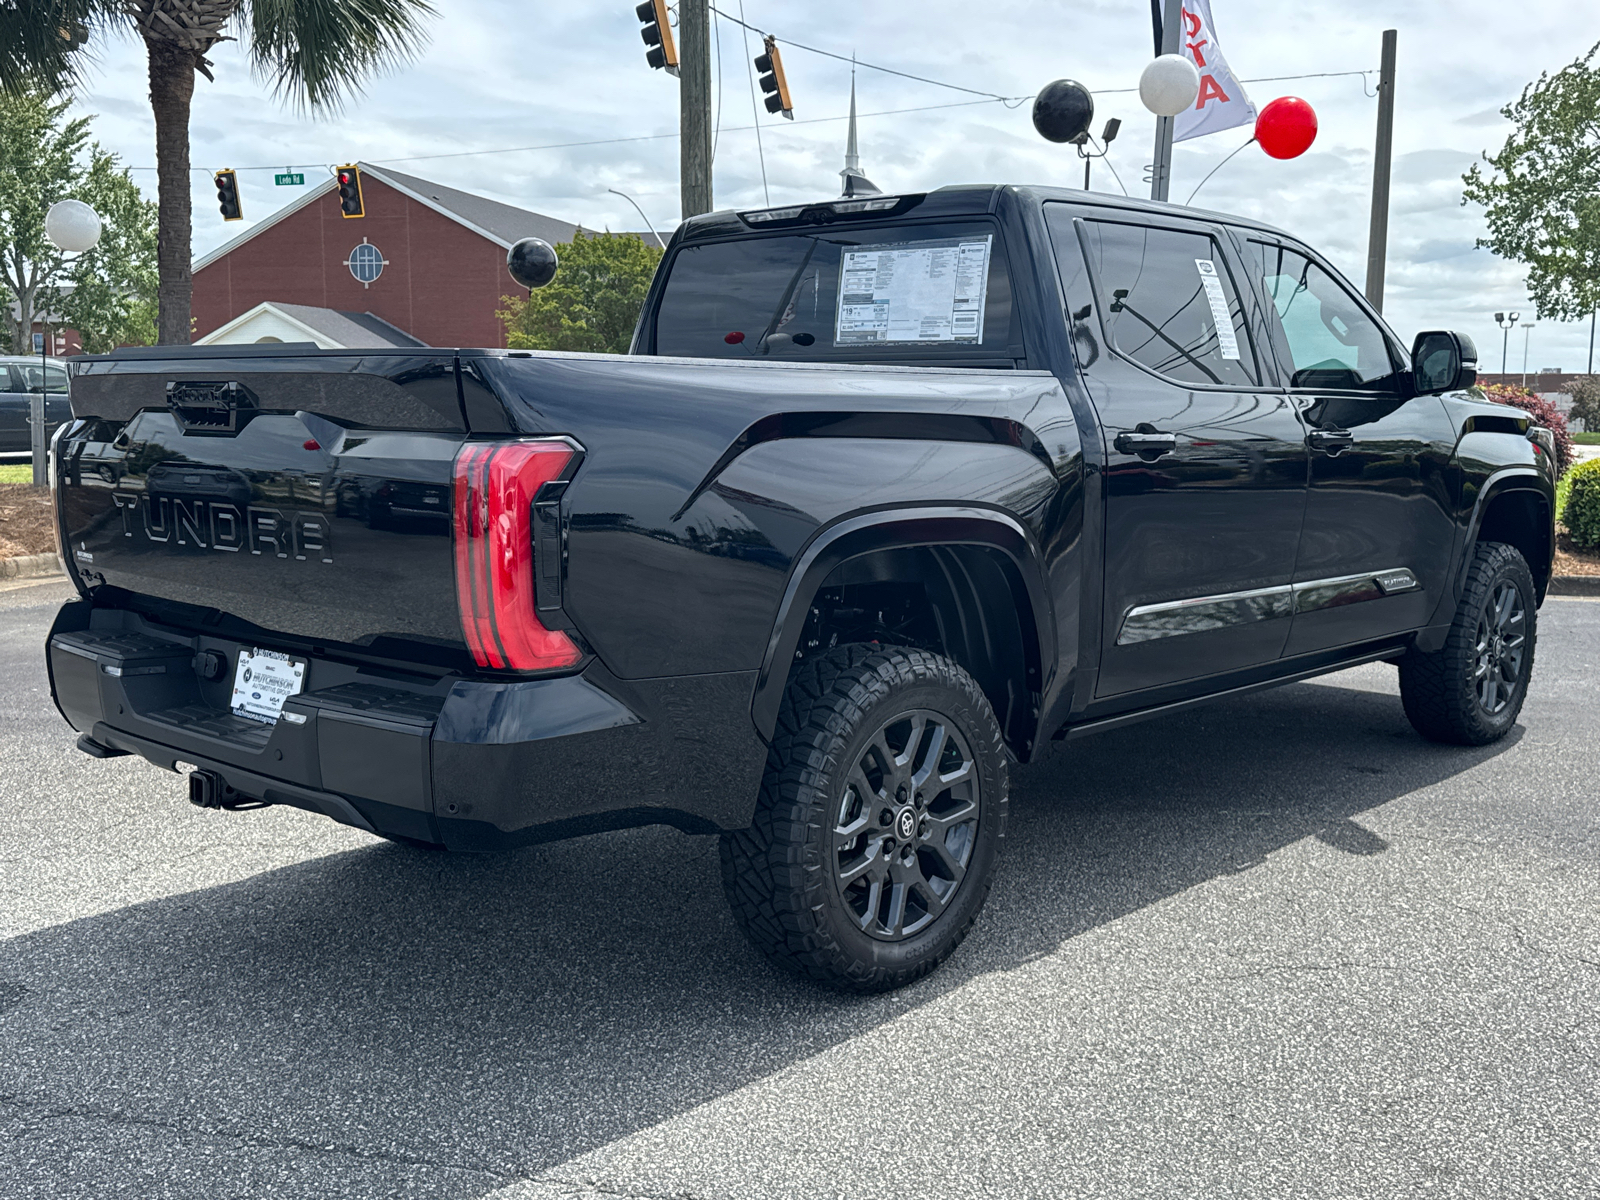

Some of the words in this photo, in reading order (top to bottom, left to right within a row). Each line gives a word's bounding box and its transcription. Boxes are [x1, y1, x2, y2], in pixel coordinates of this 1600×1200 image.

[279, 175, 291, 185] Ledo
[292, 174, 300, 184] Rd
[111, 491, 334, 565] TUNDRA
[253, 673, 294, 690] HUTCHINSON
